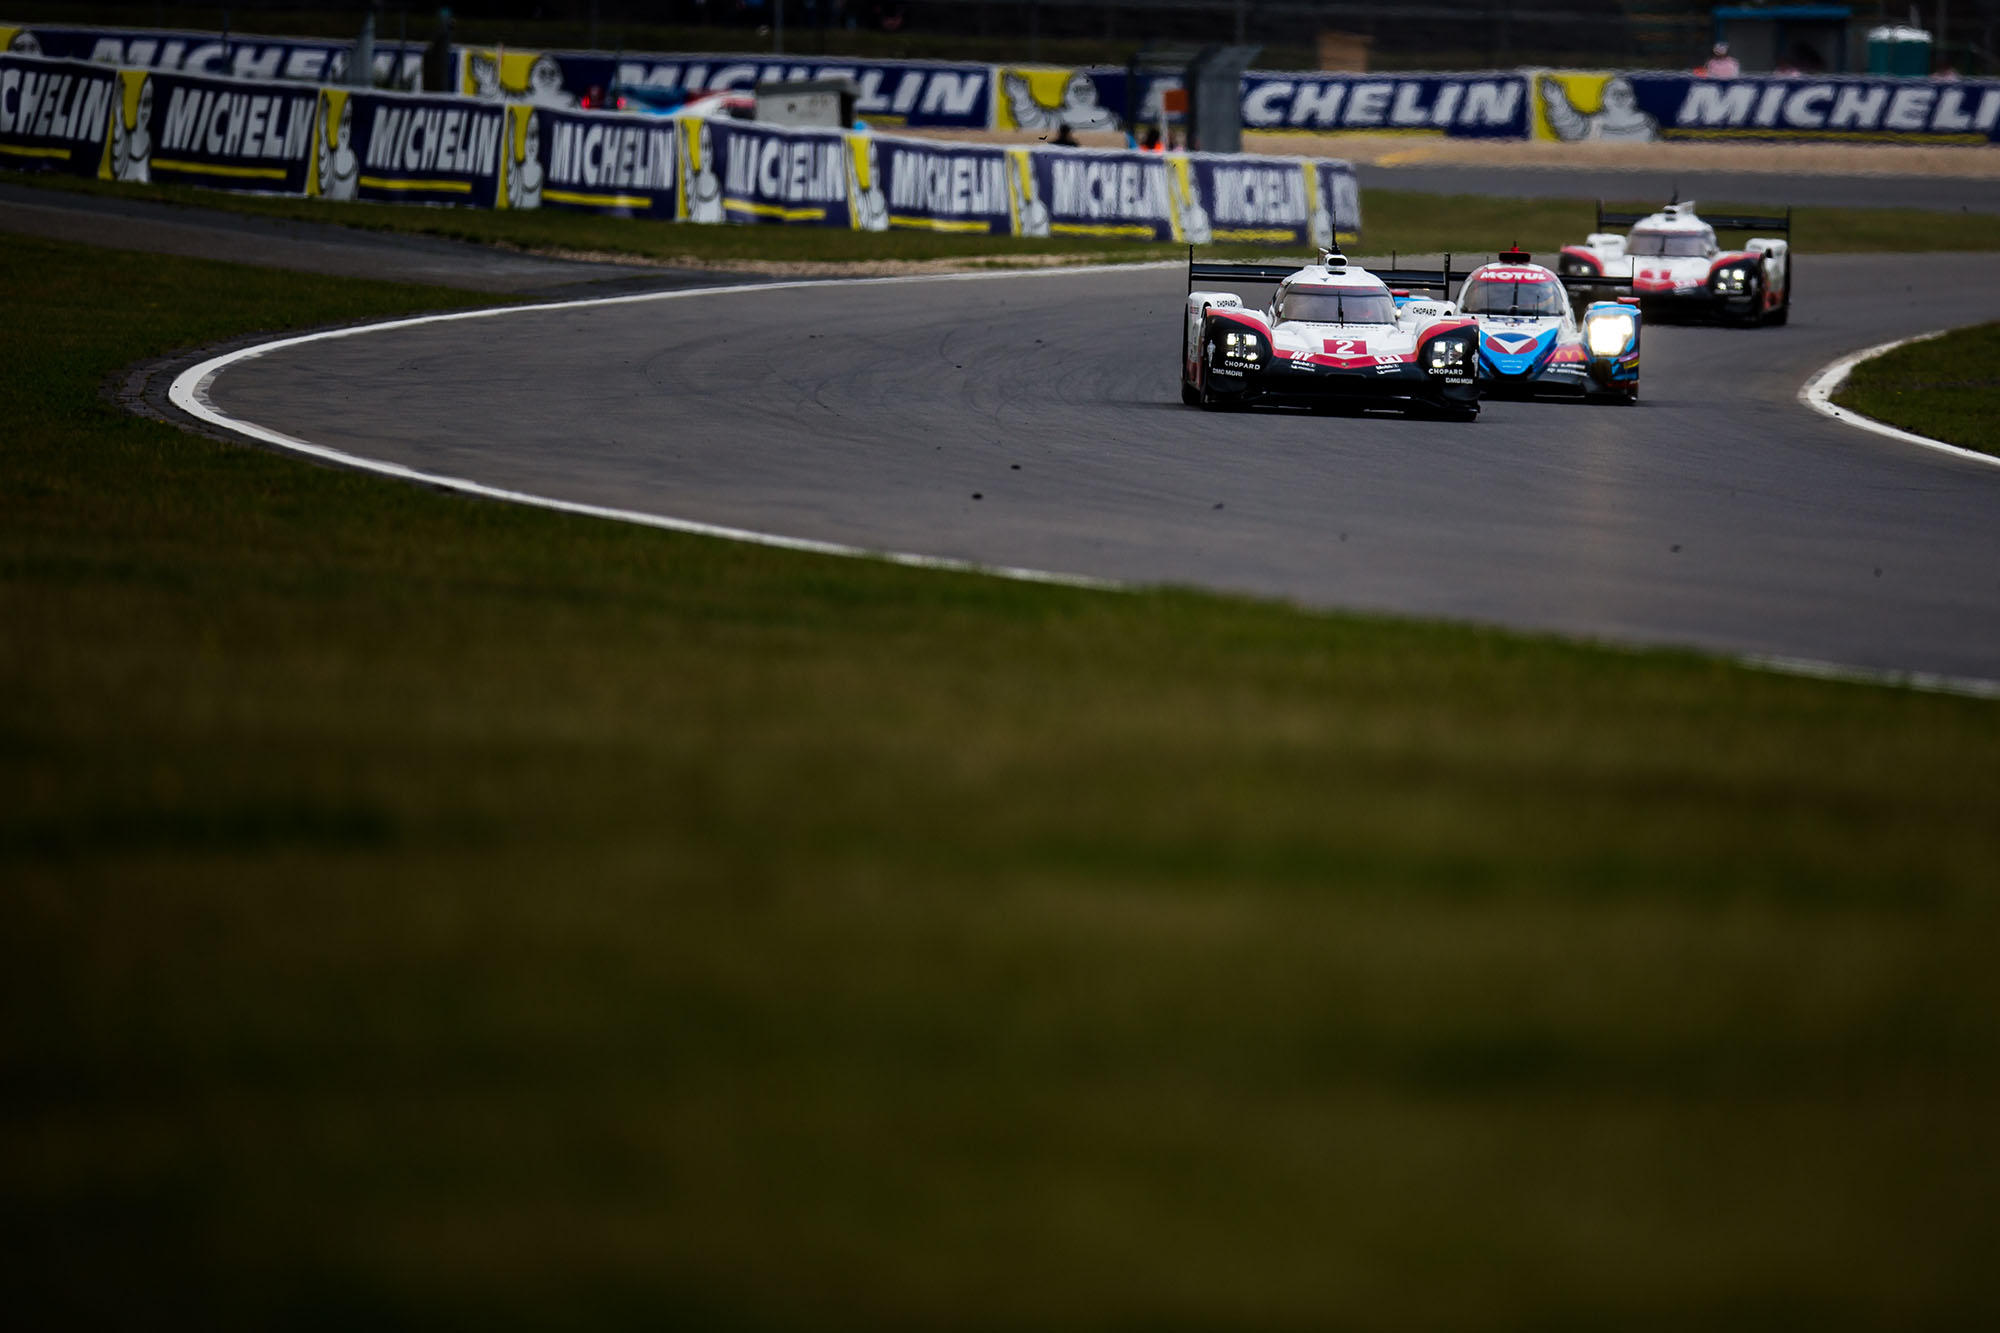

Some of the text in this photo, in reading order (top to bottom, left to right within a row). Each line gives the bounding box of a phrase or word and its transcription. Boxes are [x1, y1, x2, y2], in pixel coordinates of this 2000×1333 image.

[90, 38, 424, 92] MICHEN
[613, 63, 985, 114] MICLIN
[1137, 78, 1520, 127] CHELIN
[0, 67, 113, 143] CHELIN
[160, 86, 316, 160] MICHELIN
[366, 105, 500, 176] MICHELIN
[548, 119, 674, 190] MICHELIN
[725, 132, 846, 202] MICHELIN
[1480, 271, 1546, 281] MOTUL
[1216, 300, 1238, 308] CHOPARD
[1412, 307, 1437, 317] CHOPARD
[1290, 351, 1315, 361] HY
[1335, 340, 1355, 354] 2
[1379, 355, 1399, 363] P1
[1224, 360, 1261, 371] CHOPARD
[1428, 368, 1463, 376] CHOPARD
